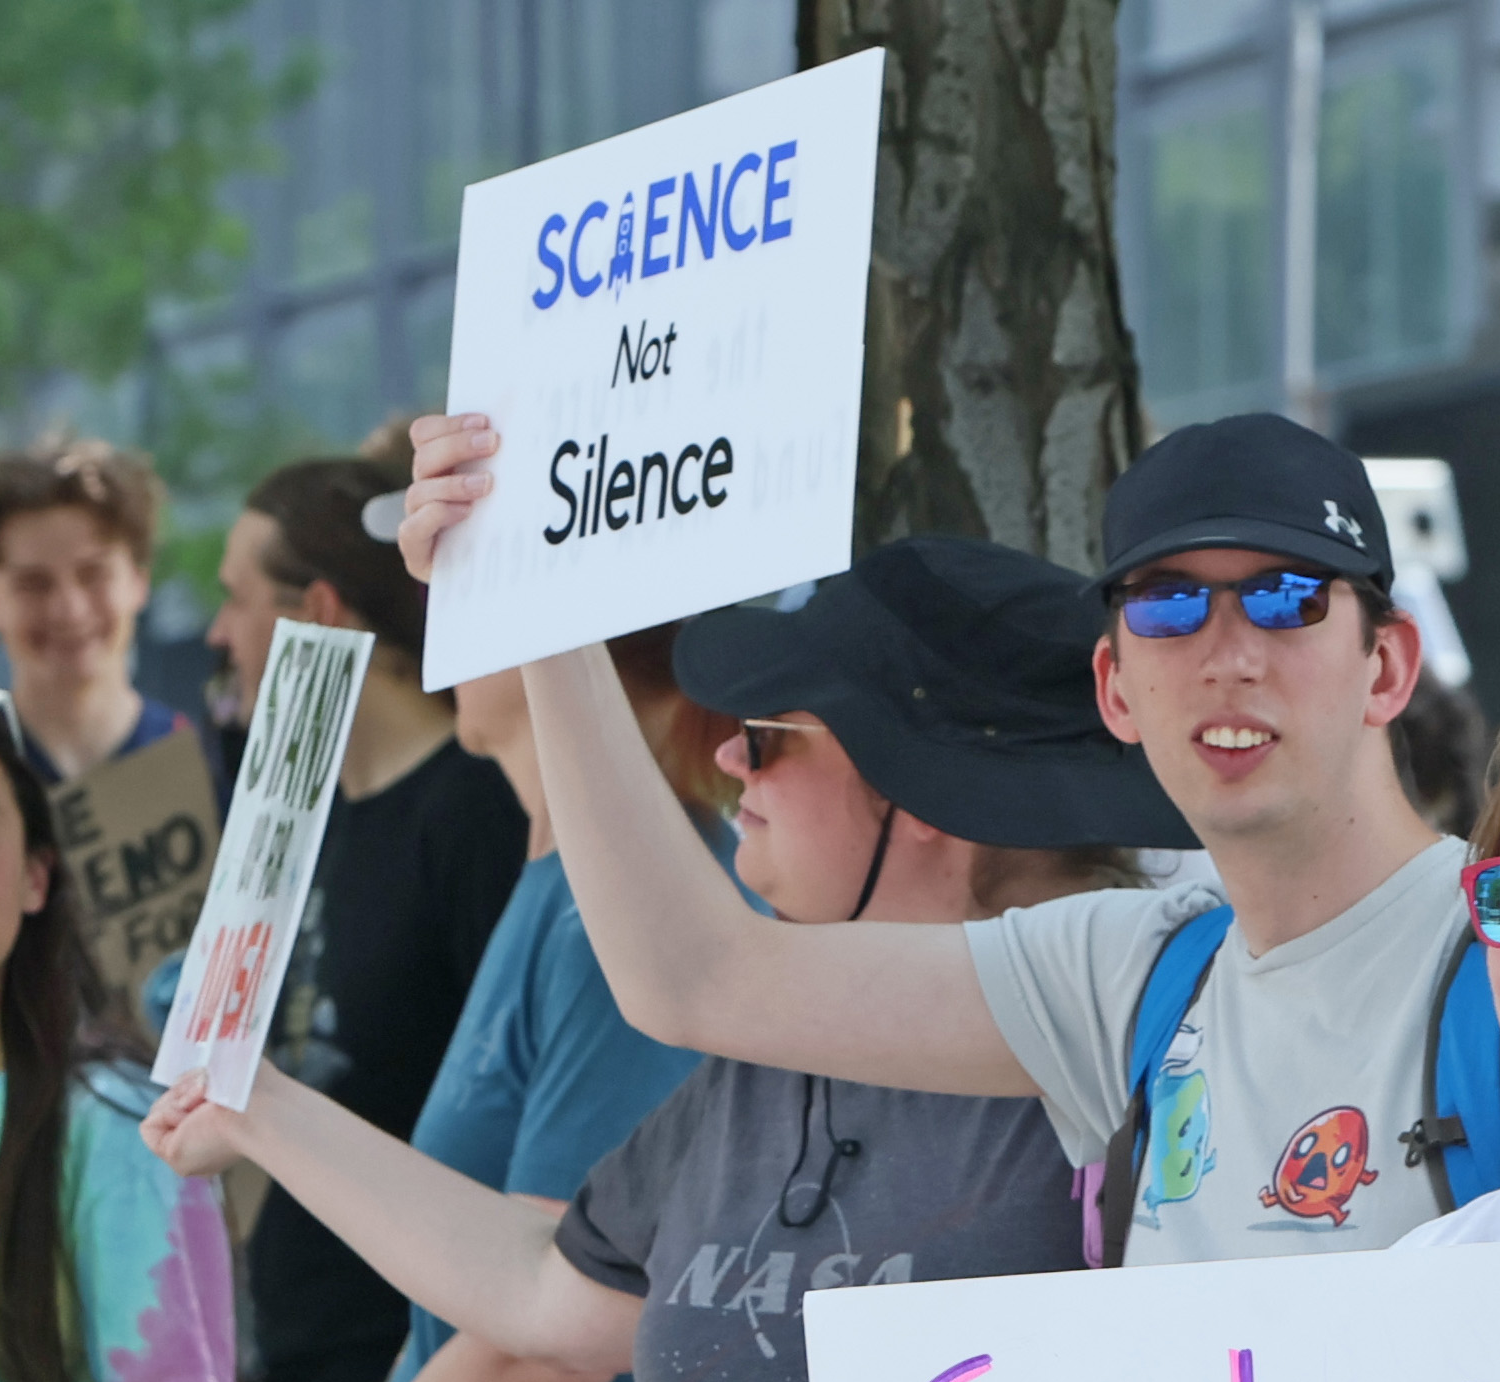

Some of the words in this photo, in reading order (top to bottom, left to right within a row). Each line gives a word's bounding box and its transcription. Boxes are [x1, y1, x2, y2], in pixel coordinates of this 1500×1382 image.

[611, 319, 678, 389] Not
[542, 434, 734, 545] Silence
[247, 637, 355, 811] STAND
